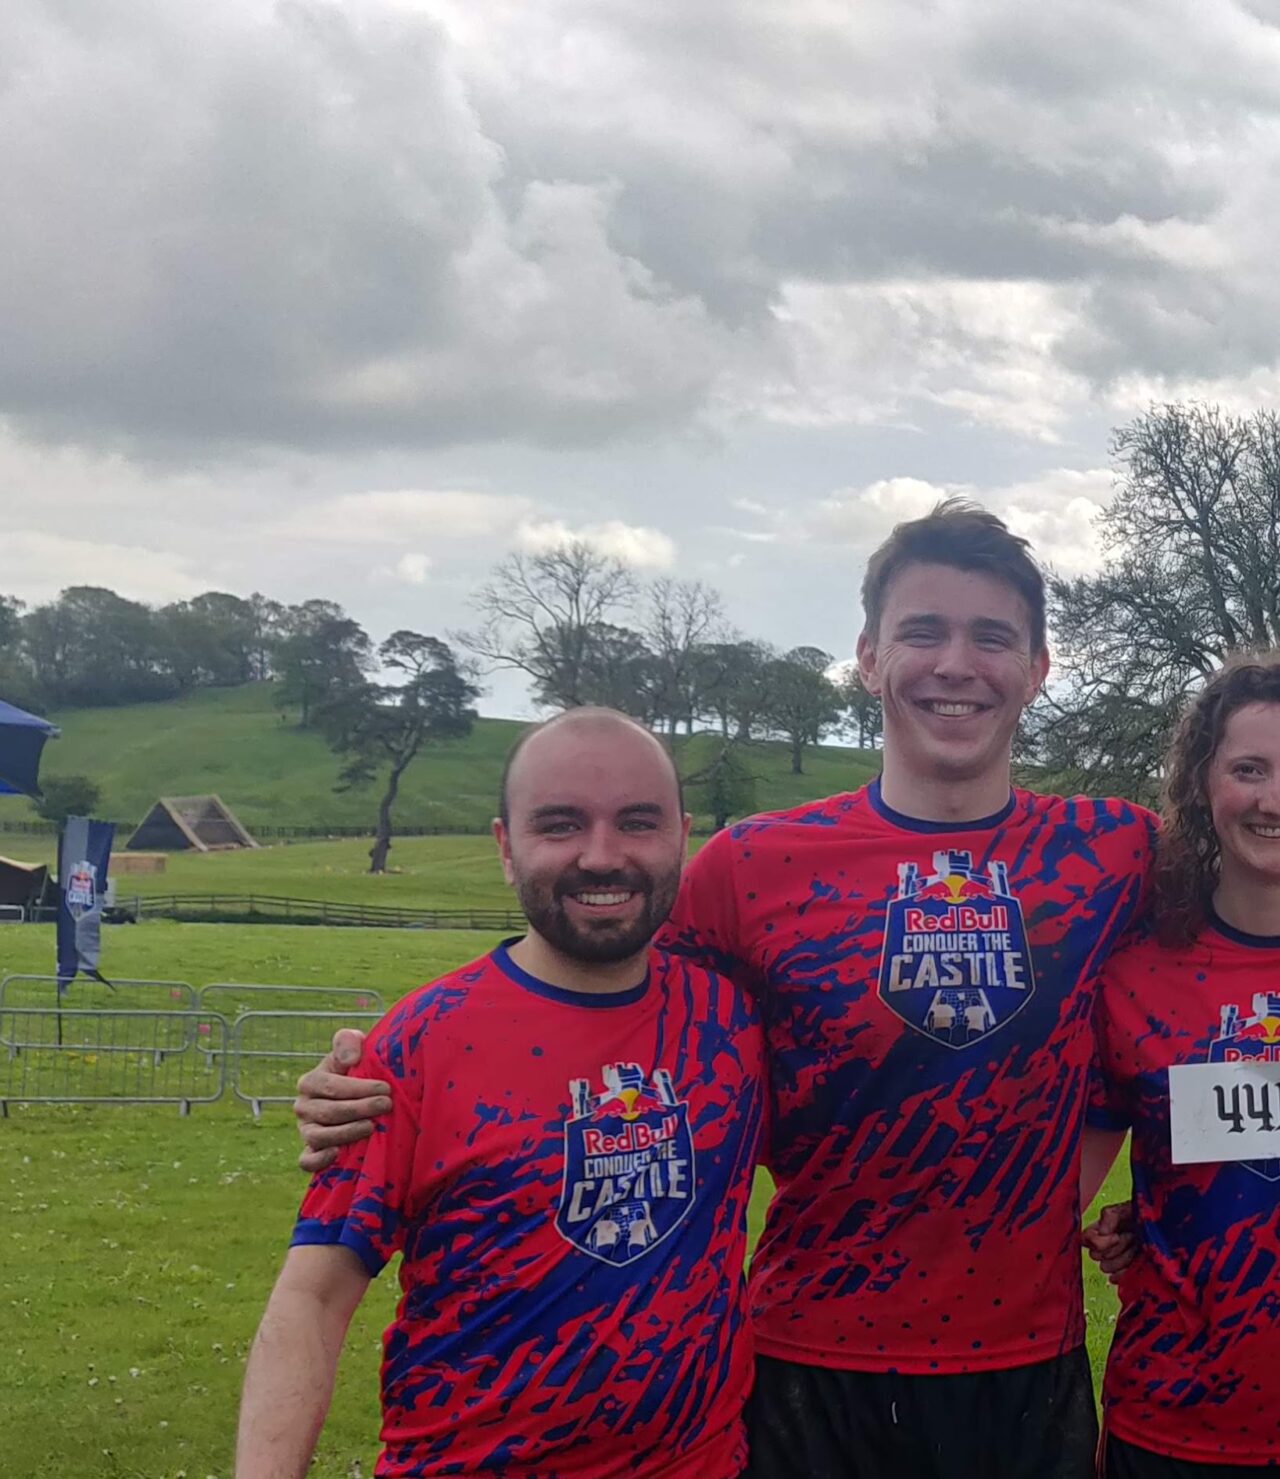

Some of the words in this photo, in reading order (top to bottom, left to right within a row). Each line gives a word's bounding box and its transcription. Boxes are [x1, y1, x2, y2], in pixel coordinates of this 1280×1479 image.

[902, 934, 978, 953] CONQUER
[982, 933, 1012, 950] THE
[888, 952, 1026, 992] CASTLE
[567, 1160, 688, 1222] CASTLE
